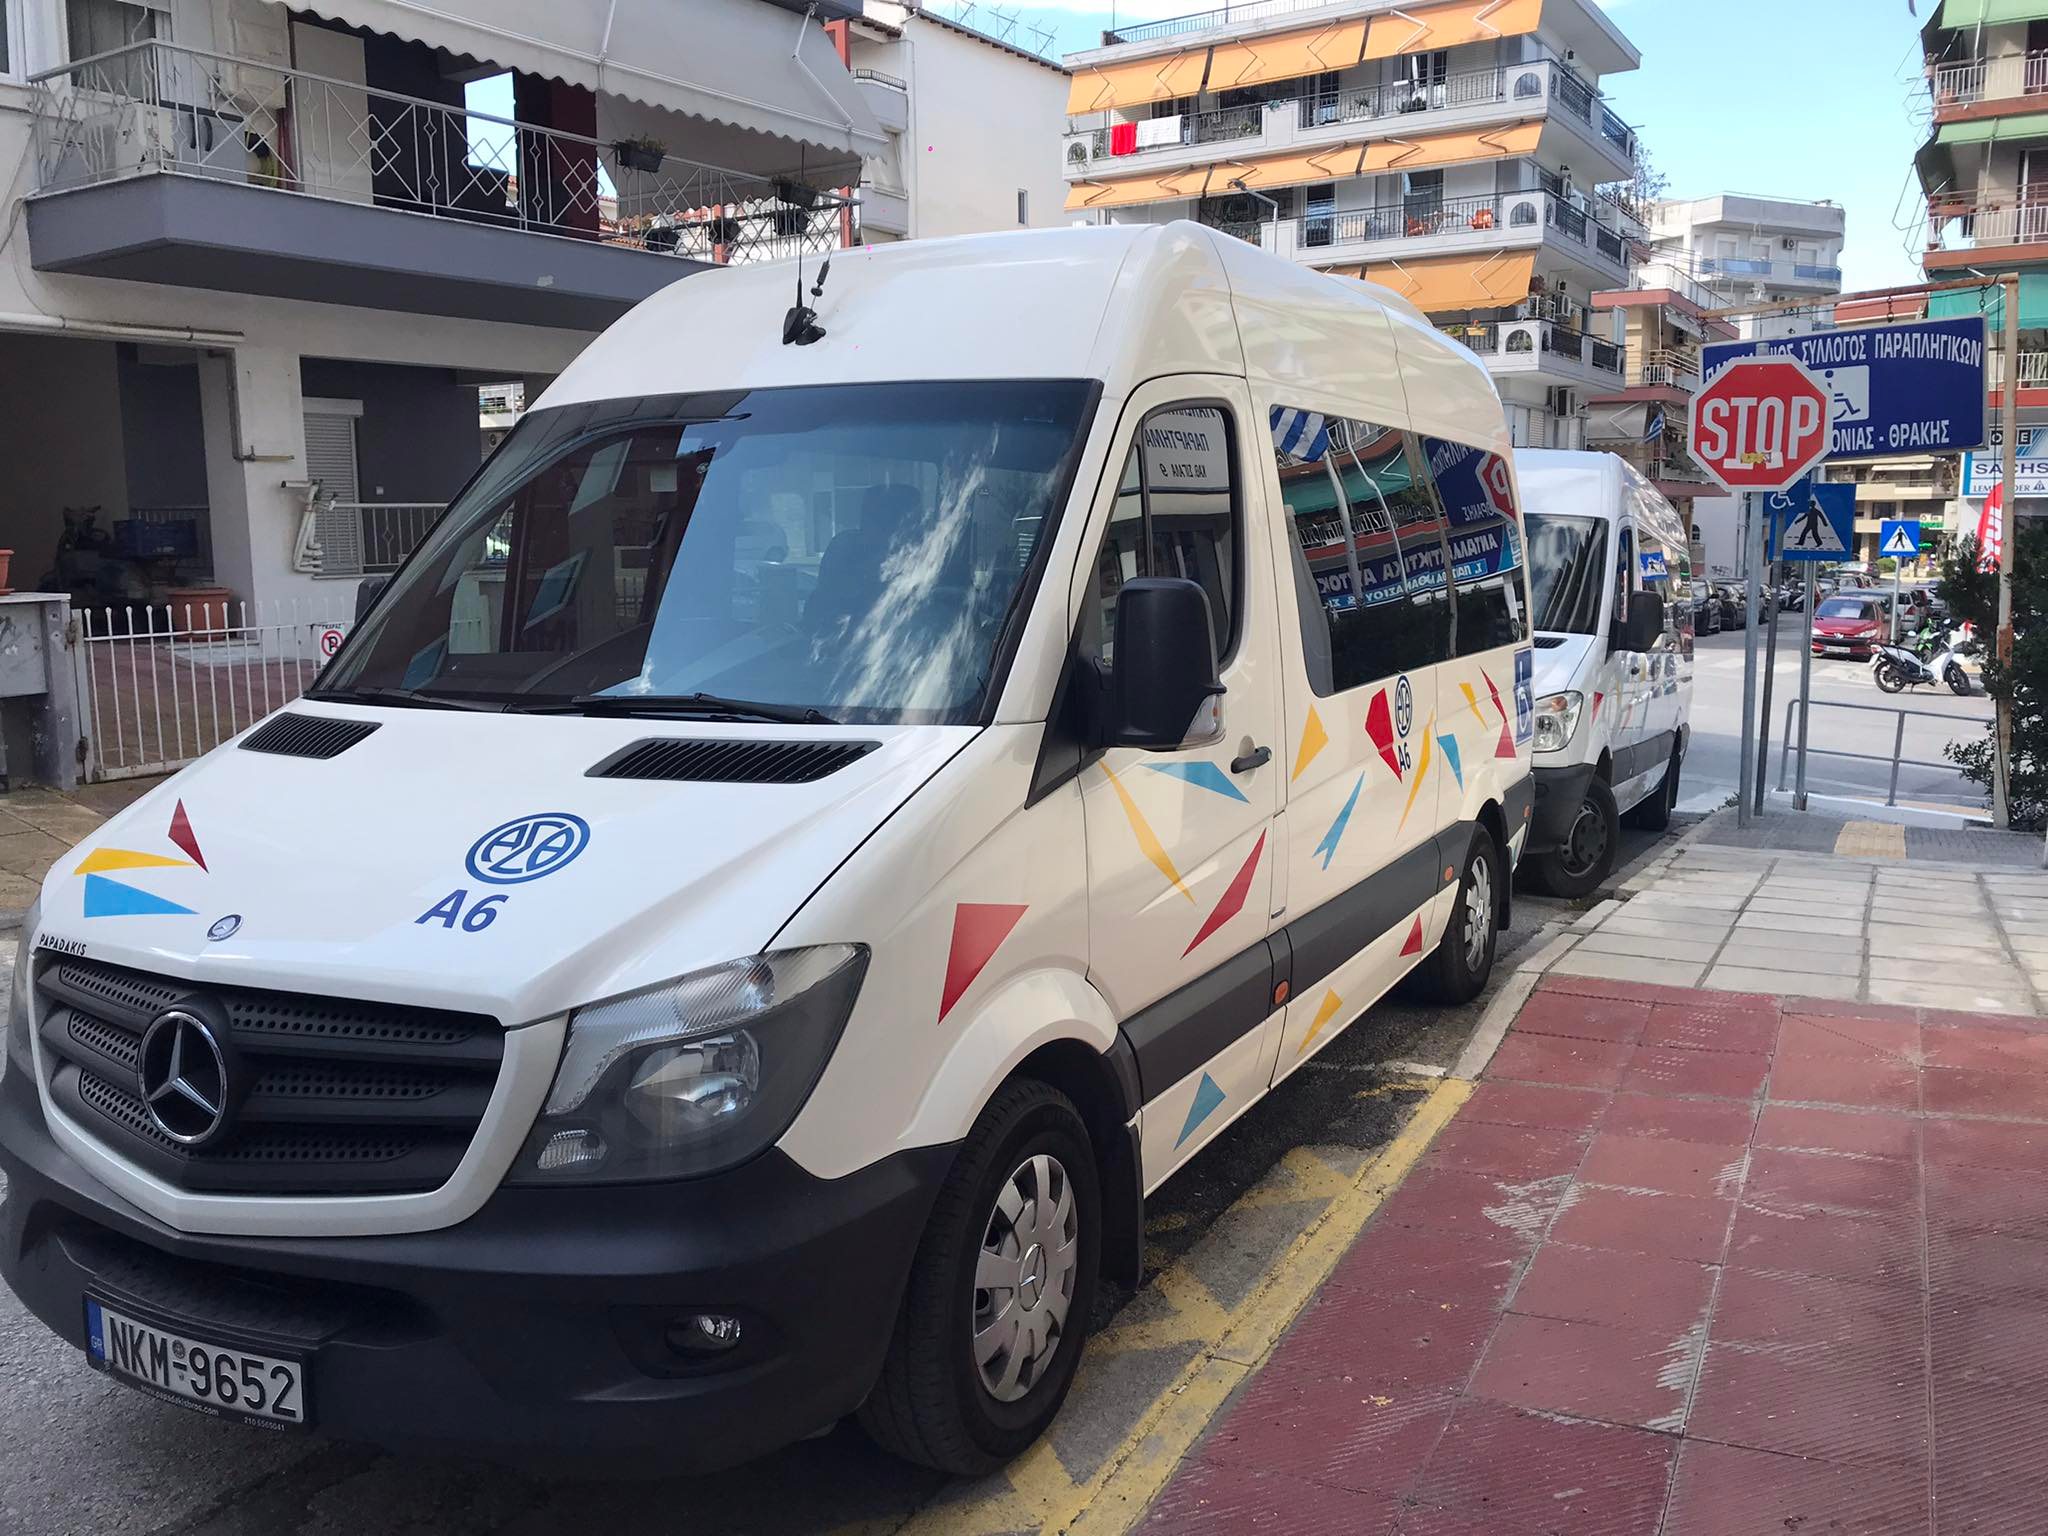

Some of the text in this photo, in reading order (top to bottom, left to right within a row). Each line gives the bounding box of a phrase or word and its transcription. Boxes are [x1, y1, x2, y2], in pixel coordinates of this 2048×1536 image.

[1801, 333, 1867, 367] ΣΥΛΛΟΓΟΣ
[1874, 333, 1982, 368] ΠΑΡΑΠΛΗΓΙΚΩΝ
[1701, 396, 1820, 469] STOP
[1832, 426, 1875, 452] ΟΝΙΑΣ
[1889, 420, 1950, 448] ΘΡΑΚΗΣ
[1975, 462, 2048, 475] SAHS
[1397, 741, 1412, 771] A6
[415, 889, 509, 933] A6
[38, 933, 88, 956] PAPADAKIS
